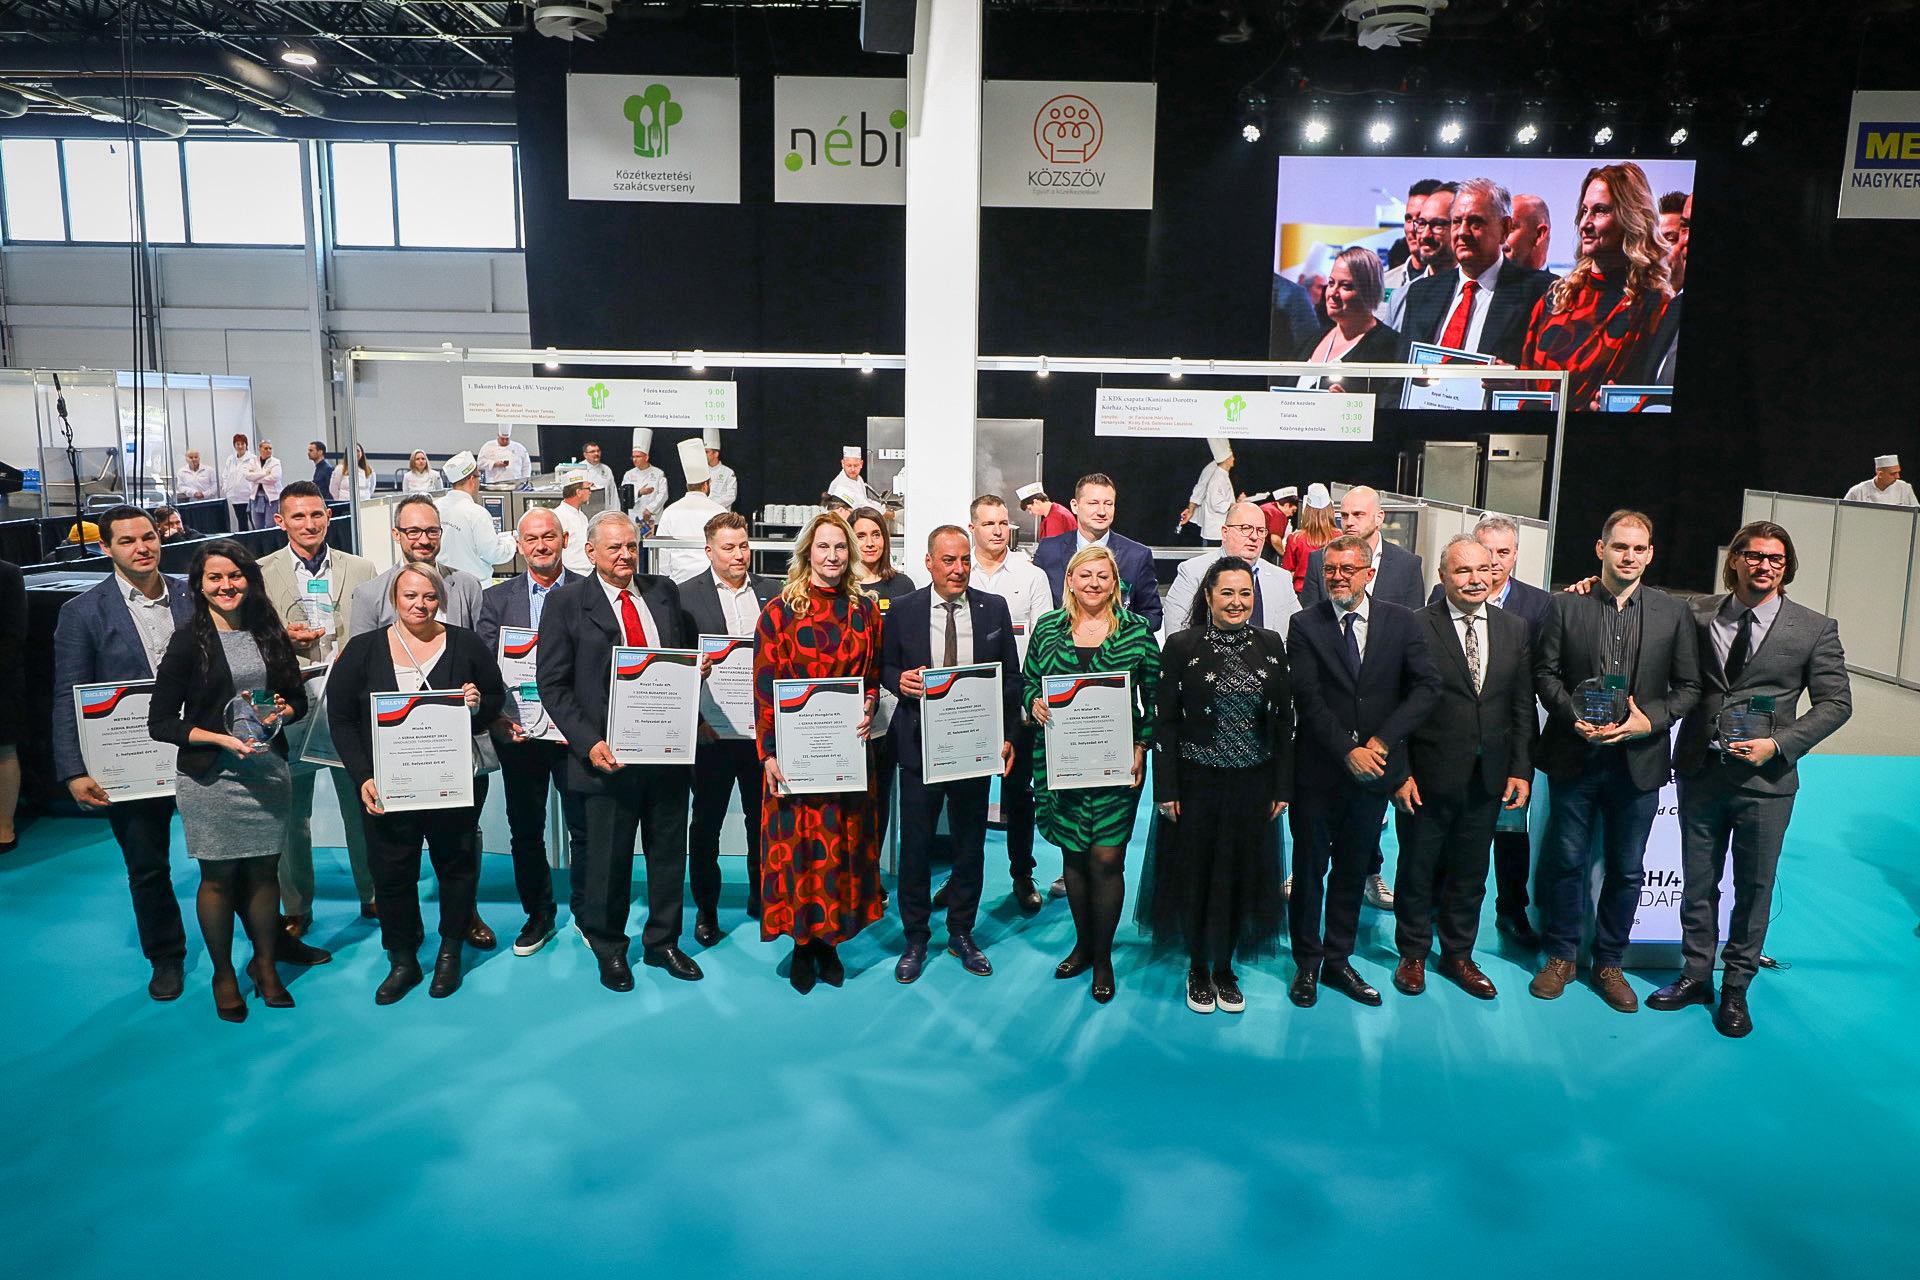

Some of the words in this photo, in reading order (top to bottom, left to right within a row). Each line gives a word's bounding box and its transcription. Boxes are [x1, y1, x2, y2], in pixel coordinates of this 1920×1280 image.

[1865, 132, 1920, 160] ME
[616, 169, 692, 183] Közétkeztetési
[1028, 168, 1106, 187] KÖZSZÖV
[613, 182, 695, 194] szakácsverseny
[705, 413, 725, 421] 13:15
[1342, 413, 1362, 421] 13:30
[1340, 426, 1361, 434] 13:45
[1668, 806, 1679, 816] C
